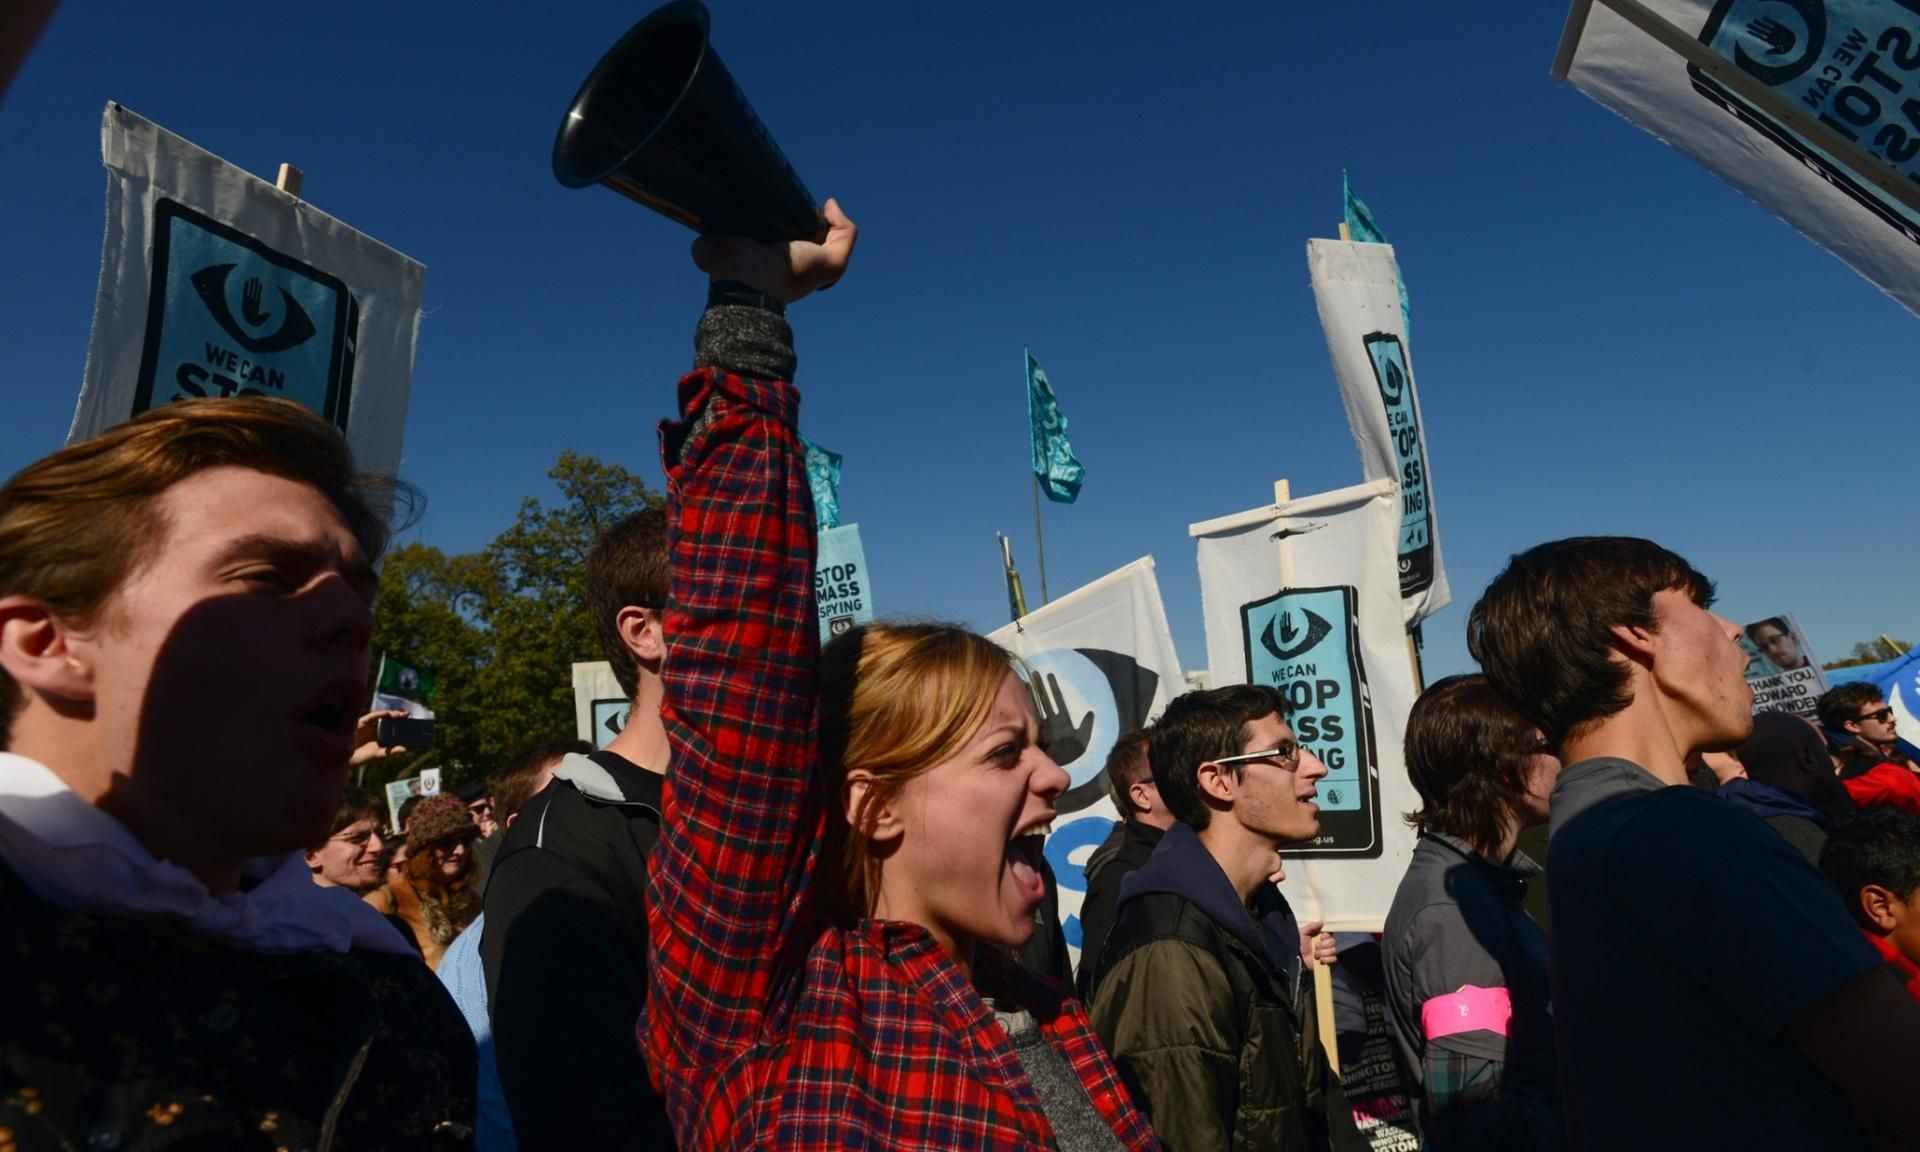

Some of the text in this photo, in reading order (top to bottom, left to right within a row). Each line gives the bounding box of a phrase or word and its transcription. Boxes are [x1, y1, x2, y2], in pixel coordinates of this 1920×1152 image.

[206, 342, 285, 390] WE CAN
[171, 363, 265, 399] ST
[815, 563, 856, 588] STOP
[815, 581, 860, 604] MASS
[820, 599, 862, 618] SPYING
[1271, 664, 1317, 682] WE CAN
[1754, 684, 1807, 704] EDWARD
